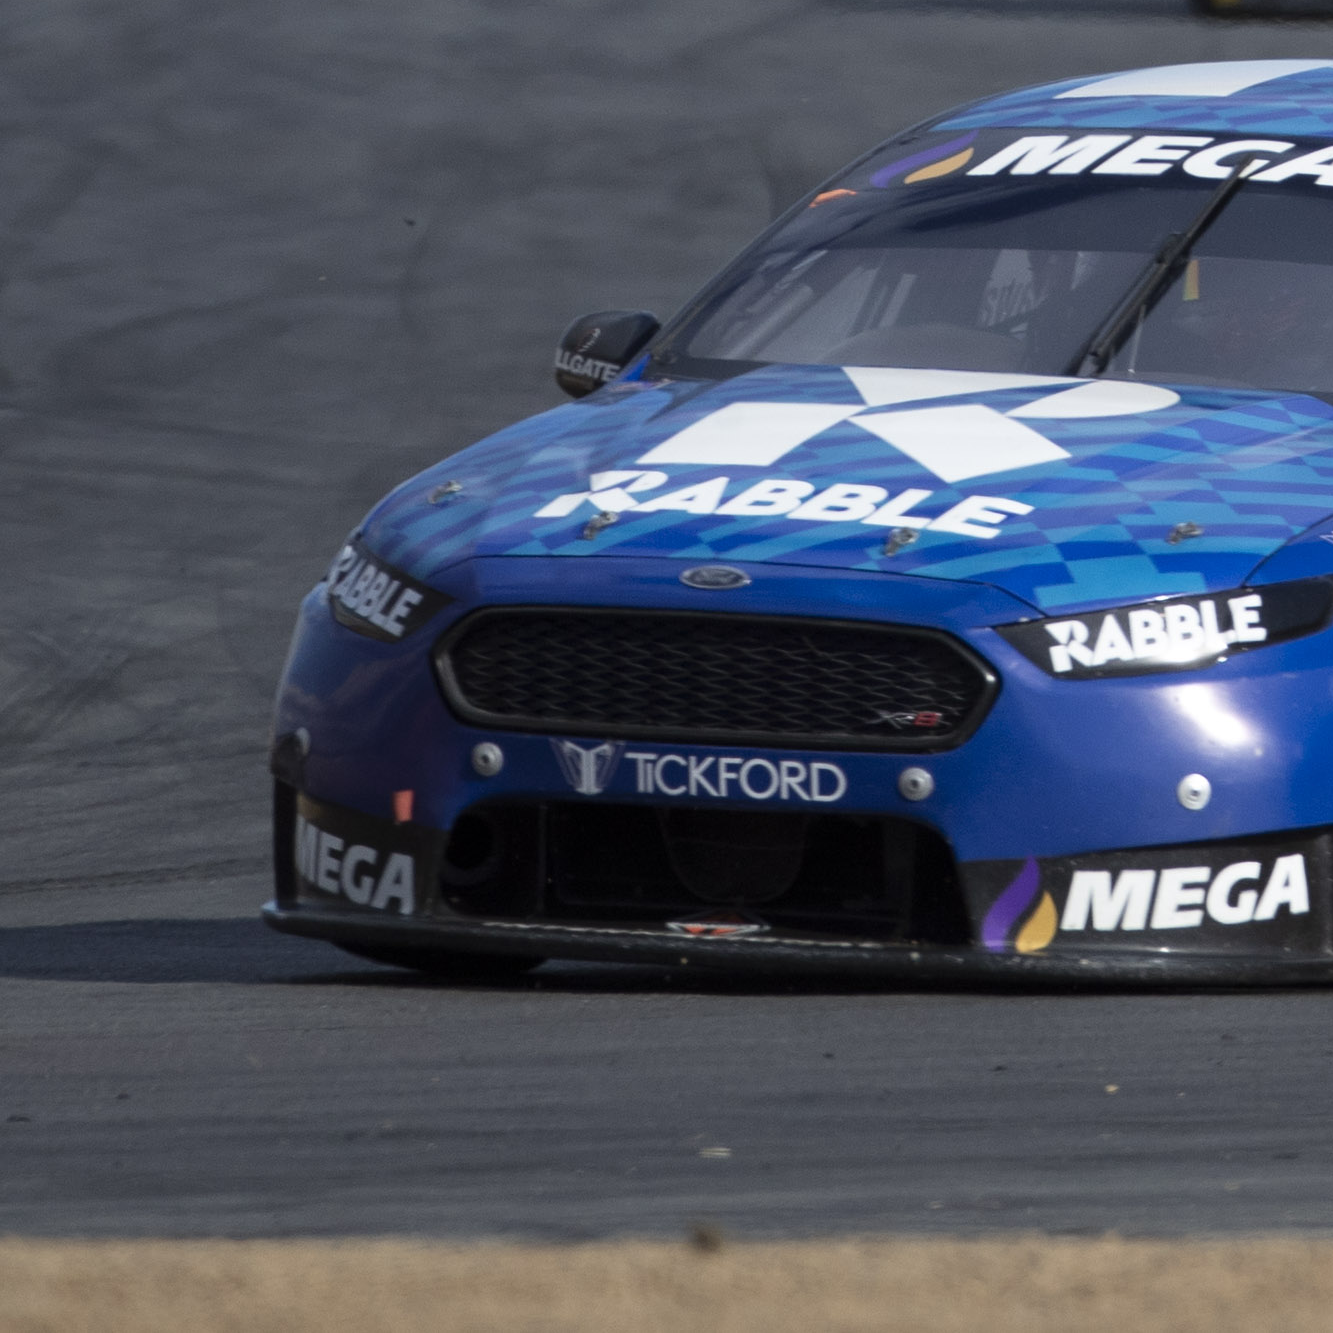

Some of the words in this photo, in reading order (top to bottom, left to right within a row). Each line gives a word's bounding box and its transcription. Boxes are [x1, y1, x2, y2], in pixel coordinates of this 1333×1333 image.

[555, 348, 622, 383] LLGATE
[533, 469, 1035, 540] RABBLE
[327, 545, 424, 638] RABBLE
[1044, 594, 1267, 673] RABBLE
[624, 751, 848, 802] TICKFORD
[295, 814, 415, 915] MEGA
[1059, 854, 1310, 932] MEGA
